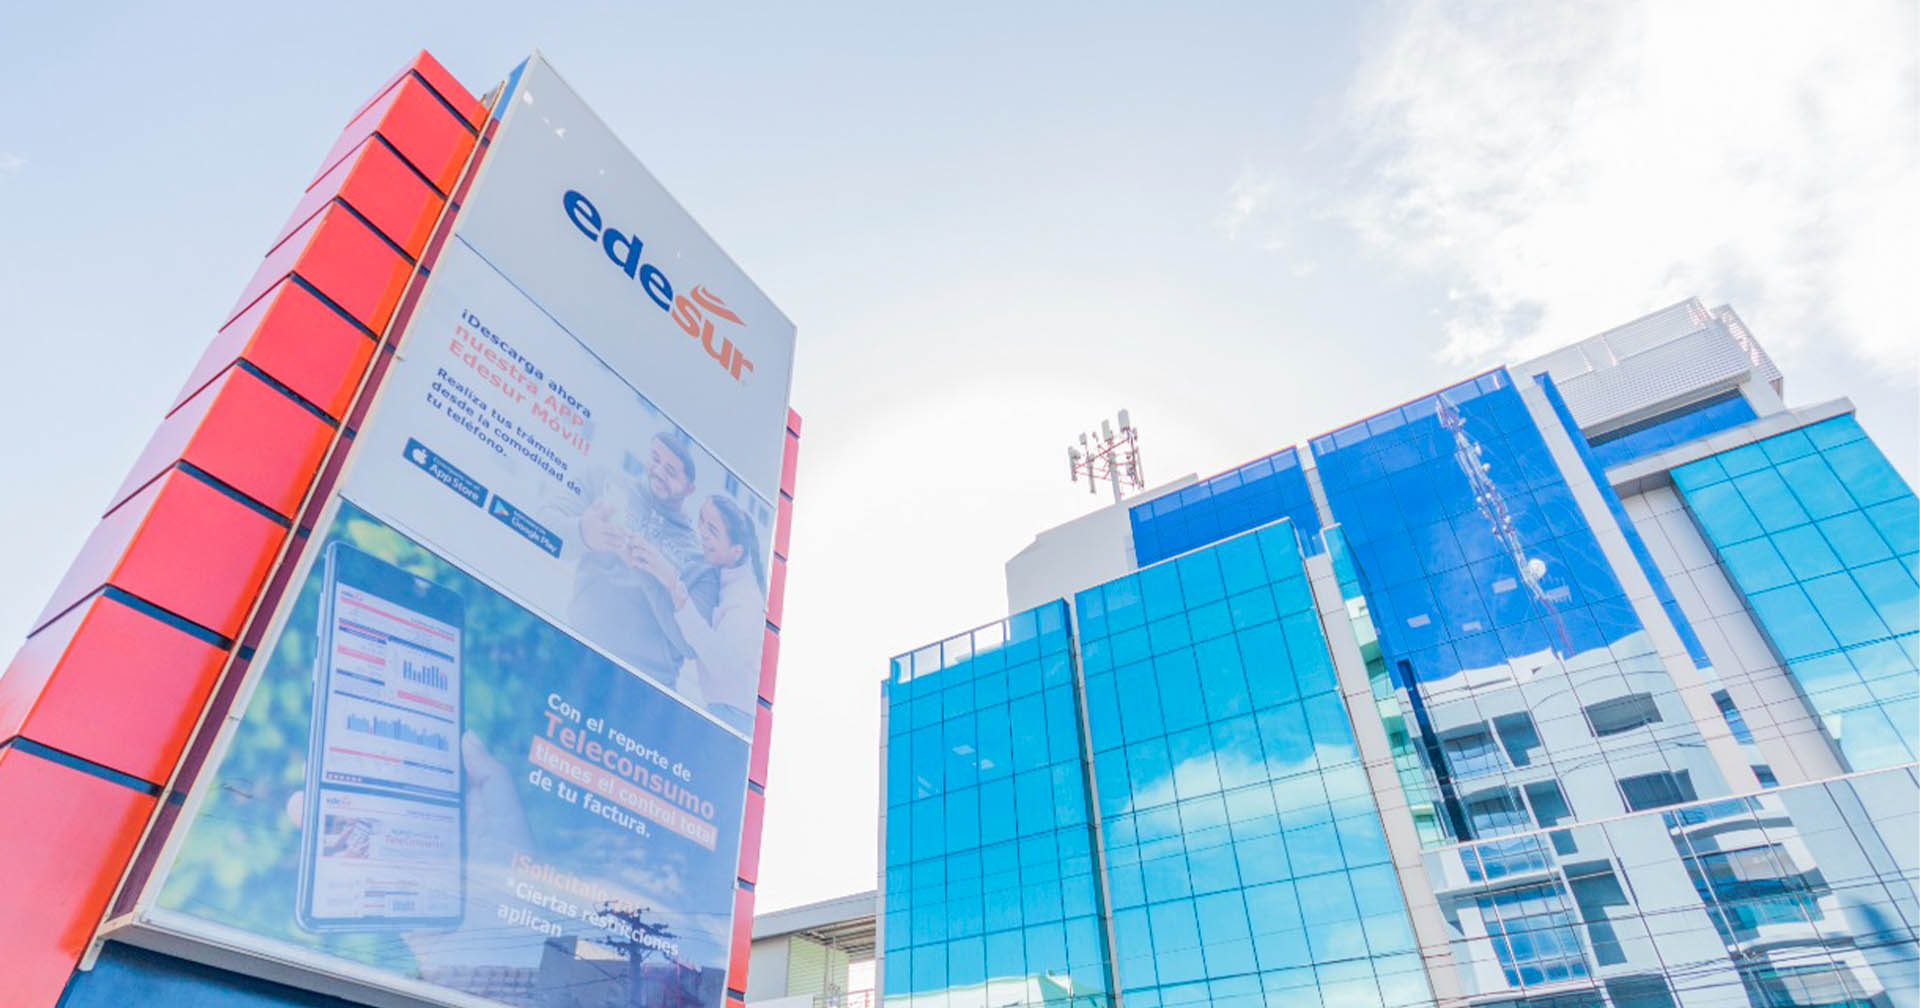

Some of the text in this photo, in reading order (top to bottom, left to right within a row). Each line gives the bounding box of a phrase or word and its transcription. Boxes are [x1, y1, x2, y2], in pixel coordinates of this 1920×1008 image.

[563, 189, 754, 381] edesur
[450, 339, 526, 404] Edesur
[455, 325, 585, 428] nuestra App
[548, 380, 591, 418] ahora
[426, 392, 507, 457] tu teléfono.
[432, 381, 475, 416] desde
[477, 414, 490, 429] la
[494, 428, 564, 482] comodidad
[566, 478, 581, 495] de
[437, 368, 568, 471] Realiza tus trámites
[429, 464, 452, 483] App
[453, 478, 480, 501] Store
[544, 710, 715, 819] Teleconsumo
[548, 693, 692, 782] Con el reporte de
[529, 769, 651, 838] de tu factura.
[534, 743, 716, 846] tienes el control total
[497, 903, 563, 938] aplican
[583, 909, 679, 956] restricciones
